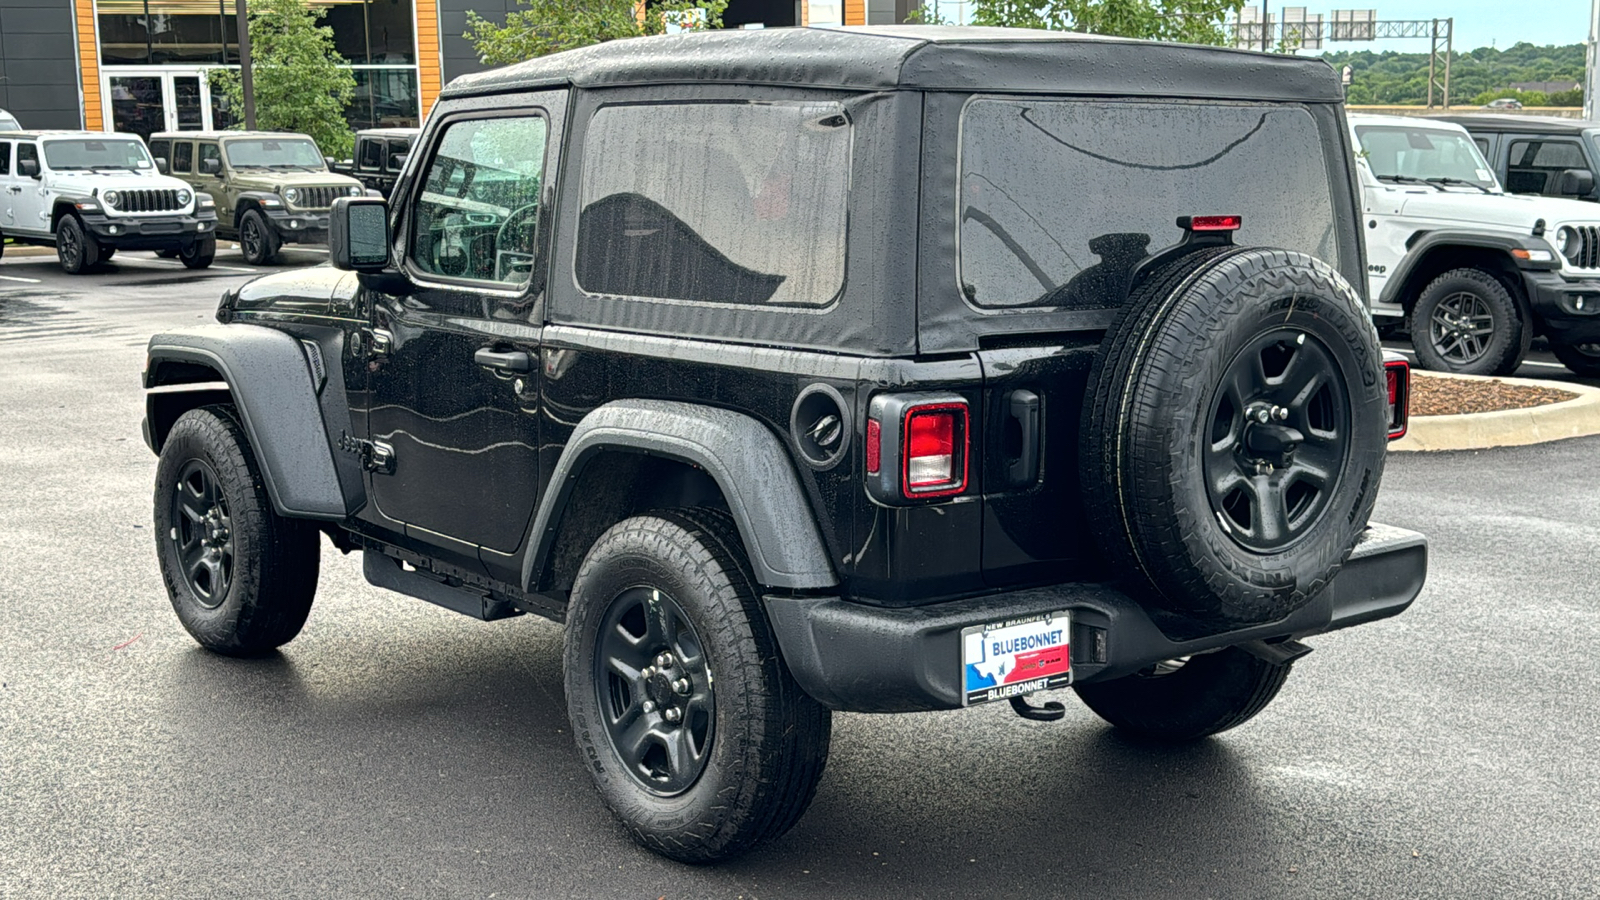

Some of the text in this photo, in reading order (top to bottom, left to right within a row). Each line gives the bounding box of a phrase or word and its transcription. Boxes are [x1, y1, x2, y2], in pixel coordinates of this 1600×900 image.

[1368, 264, 1386, 274] eep
[985, 613, 1050, 631] NEW BRAUNFELS
[992, 630, 1063, 656] BLUEBONNET
[987, 678, 1049, 701] BLUEBONNET
